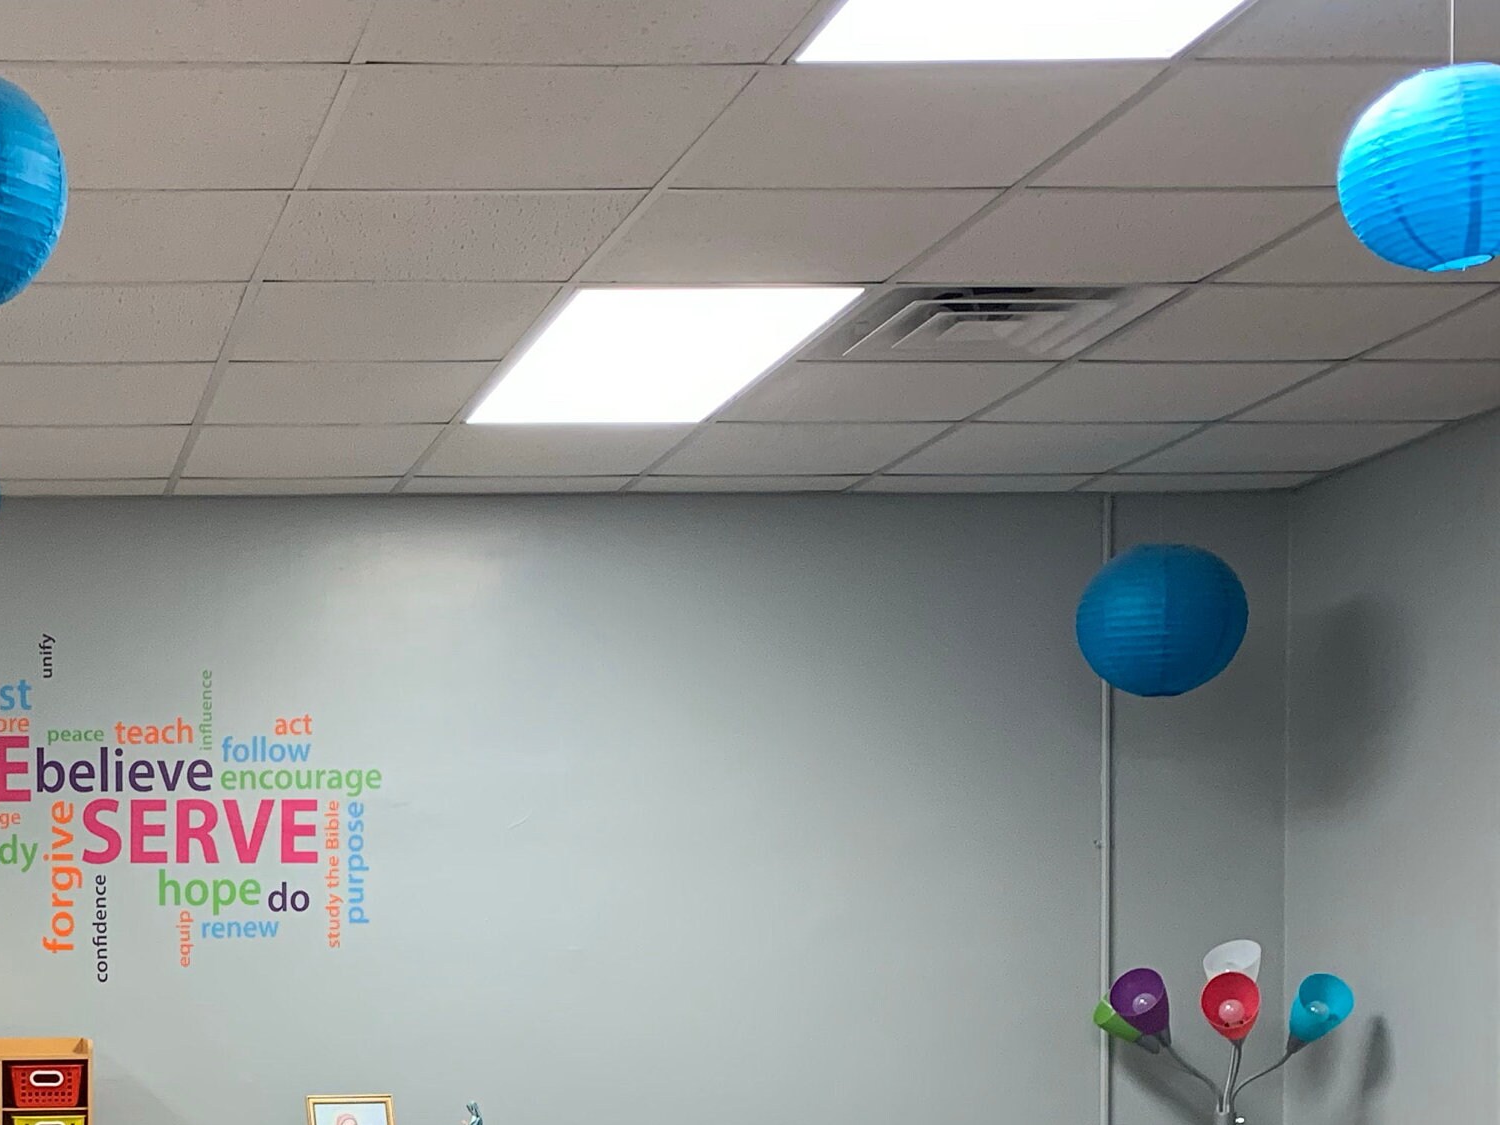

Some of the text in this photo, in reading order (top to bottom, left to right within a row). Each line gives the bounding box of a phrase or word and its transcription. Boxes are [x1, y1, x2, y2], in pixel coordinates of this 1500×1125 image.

[39, 634, 55, 678] unify
[115, 717, 193, 744] teach
[200, 669, 212, 750] influence
[275, 714, 312, 735] act
[48, 730, 104, 746] peace
[221, 736, 311, 762] follow
[37, 747, 212, 793] believe
[220, 769, 381, 797] encourage
[82, 798, 318, 864] SERVE
[42, 801, 82, 953] forgive
[324, 801, 343, 947] study the Bible
[348, 802, 369, 924] purpose
[159, 869, 260, 915] hope
[268, 882, 309, 912] do
[92, 875, 107, 982] confidence
[176, 911, 192, 967] equip
[202, 921, 279, 938] renew
